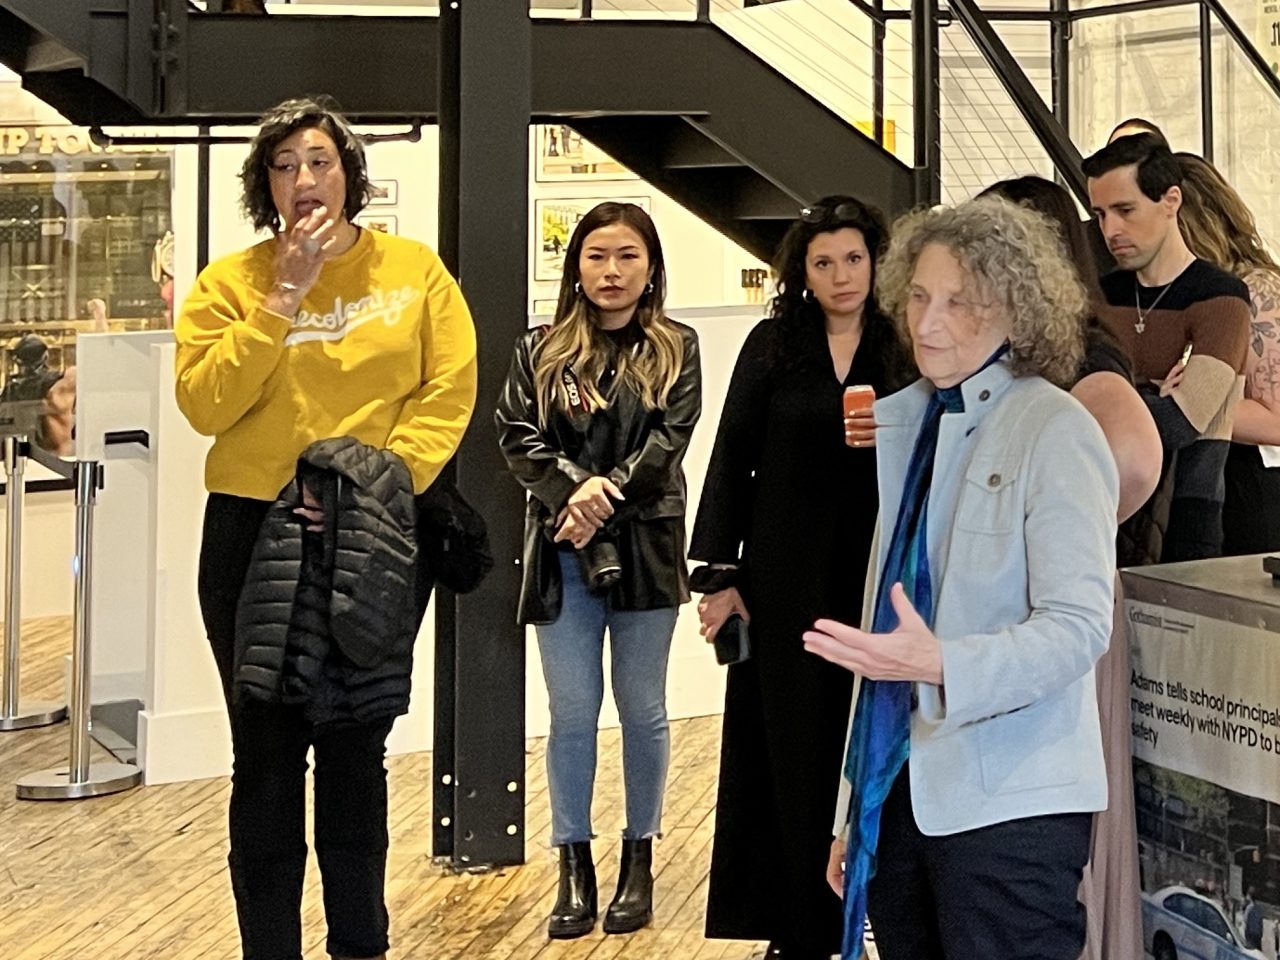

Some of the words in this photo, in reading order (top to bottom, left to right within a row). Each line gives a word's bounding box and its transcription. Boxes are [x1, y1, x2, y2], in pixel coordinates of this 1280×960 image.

[288, 286, 418, 327] ecolonize
[1130, 667, 1164, 695] Adams
[1166, 680, 1188, 702] tells
[1190, 688, 1225, 712] school
[1131, 697, 1154, 718] meet
[1156, 705, 1195, 734] weekly
[1197, 715, 1221, 738] with
[1222, 726, 1258, 748] NYPD
[1260, 731, 1273, 752] to
[1131, 721, 1158, 749] safety
